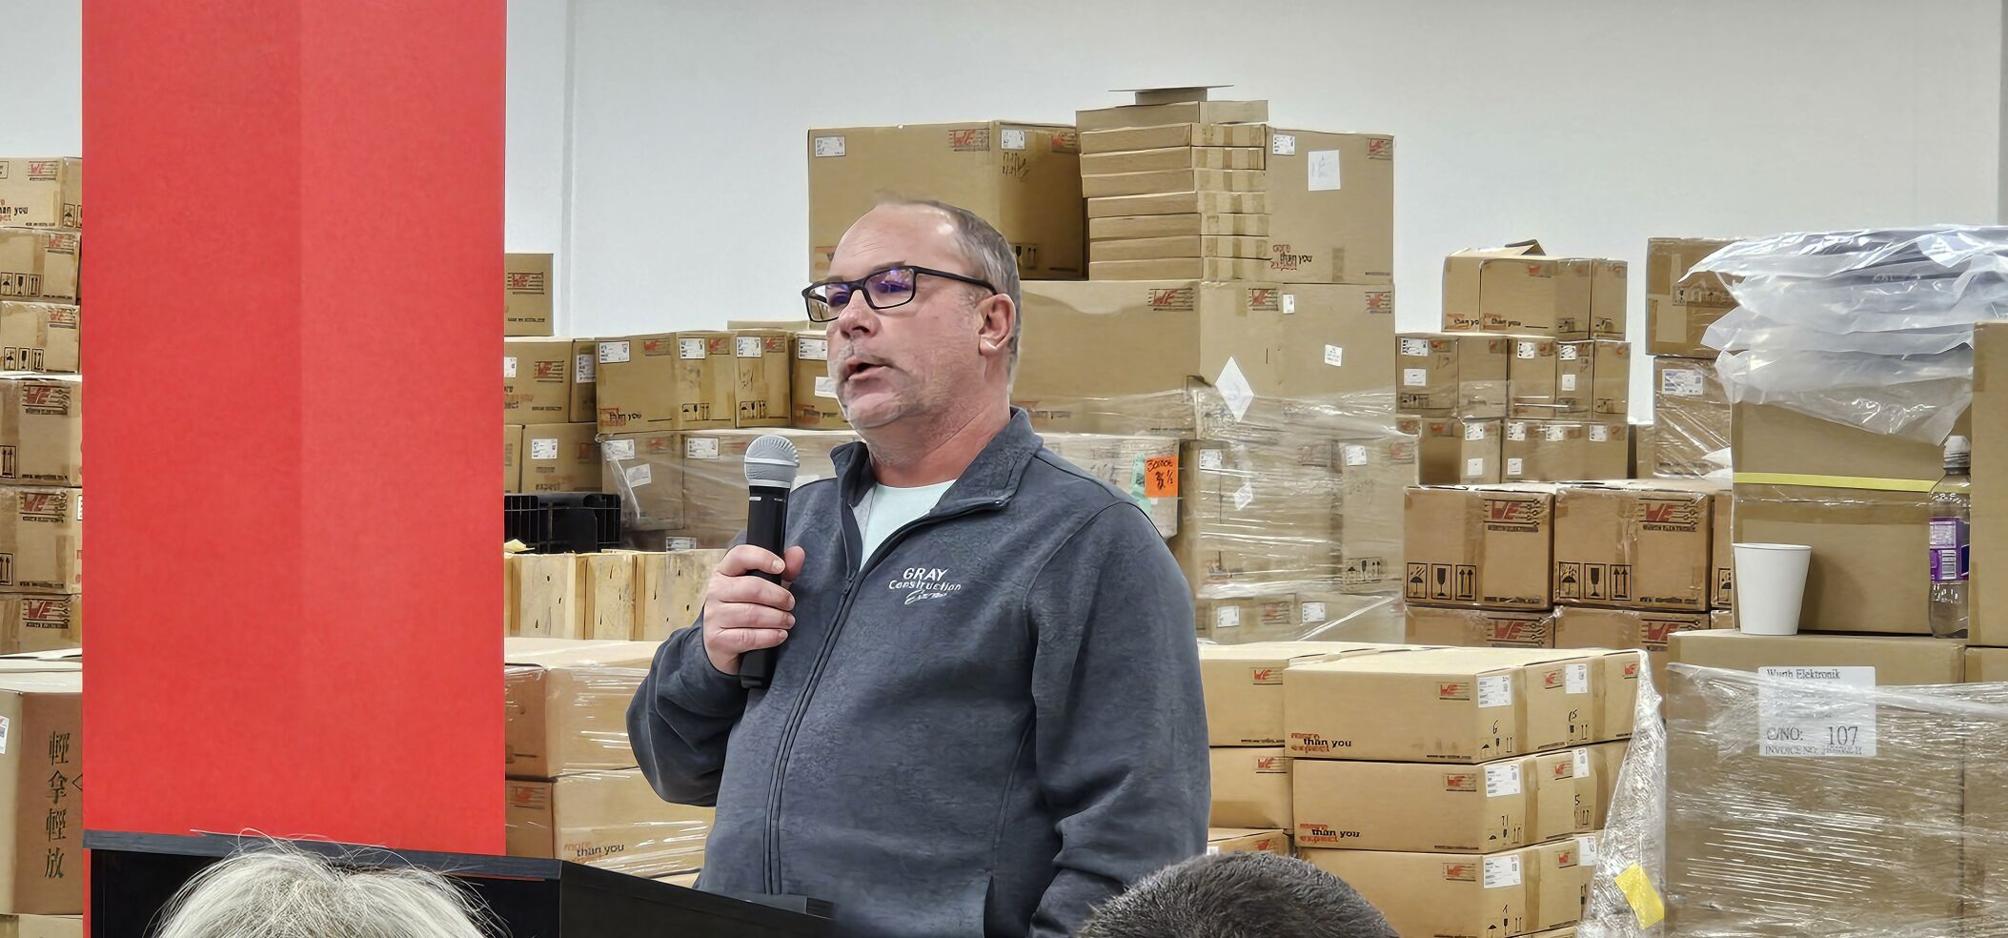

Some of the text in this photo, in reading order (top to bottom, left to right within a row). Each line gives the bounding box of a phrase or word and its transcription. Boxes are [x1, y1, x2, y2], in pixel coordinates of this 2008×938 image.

[903, 567, 949, 582] GRAY
[889, 579, 962, 592] Construction
[1796, 669, 1841, 680] Elektronik
[1766, 725, 1859, 746] C/NO: 107
[1303, 737, 1352, 748] than you
[45, 730, 71, 879] 輕拿輕放
[1339, 830, 1360, 838] you
[576, 844, 625, 857] than you
